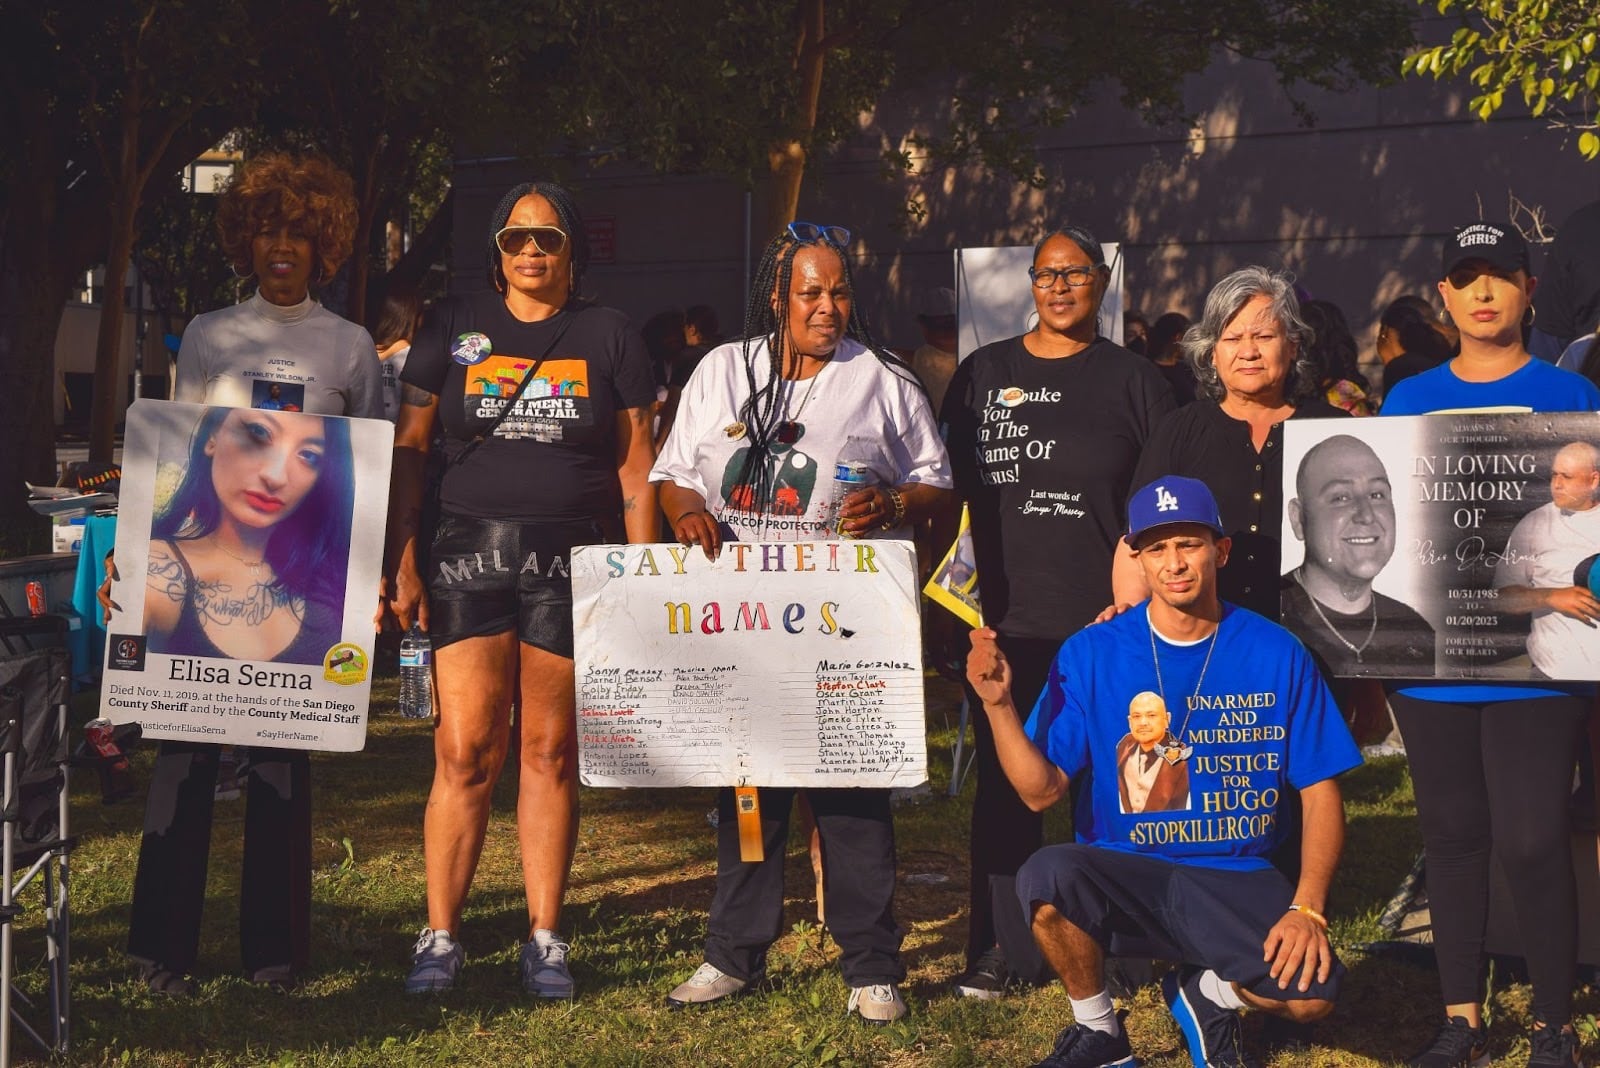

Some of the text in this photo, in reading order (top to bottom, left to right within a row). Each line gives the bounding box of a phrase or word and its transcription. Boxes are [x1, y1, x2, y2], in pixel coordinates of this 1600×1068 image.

[1457, 224, 1486, 241] JUSTICE
[1460, 233, 1497, 247] CHRIS
[267, 359, 295, 367] JUSTICE
[480, 397, 574, 409] CLOE MEN'S
[546, 408, 579, 419] JAIL
[983, 406, 1012, 424] You
[996, 421, 1029, 440] The
[1026, 440, 1056, 460] Of
[1411, 454, 1536, 476] IN LOVING
[1030, 489, 1081, 502] Last words of
[1420, 480, 1527, 501] MEMORY
[1155, 486, 1178, 511] LA
[741, 516, 764, 529] COP
[1453, 508, 1486, 528] OF
[606, 543, 879, 578] SAY THEIR
[1445, 637, 1483, 646] FOREVER
[816, 659, 851, 673] Mario
[168, 658, 313, 690] Elisa Serna
[584, 674, 662, 684] Darnell Benson
[816, 672, 877, 682] Steven Taylor
[581, 684, 611, 695] Colby
[857, 680, 887, 690] Clark
[109, 684, 134, 695] Died
[137, 686, 160, 698] Nov.
[202, 693, 212, 701] at
[216, 692, 233, 702] the
[235, 693, 267, 705] hands
[269, 696, 282, 706] of
[283, 697, 301, 707] the
[302, 698, 322, 709] San
[325, 700, 355, 713] Diego
[816, 689, 882, 698] Oscar Grant
[818, 698, 855, 706] Martin
[1187, 692, 1276, 711] UNARMED
[108, 697, 361, 724] County Sheriff and by the County Medical Staff
[816, 706, 880, 715] John Horton
[618, 716, 662, 728] Armstrong
[852, 714, 882, 724] Tyler
[1218, 711, 1257, 726] AND
[818, 721, 897, 731] Juan Correa Jr.
[256, 729, 319, 742] #SayHerName
[857, 731, 894, 739] Thomas
[1188, 726, 1286, 744] MURDERED
[847, 739, 875, 748] Malik
[878, 739, 906, 749] Young
[618, 750, 649, 759] Lopez
[818, 748, 855, 759] Stanley
[859, 747, 891, 756] Wilson
[861, 756, 876, 764] Lee
[1195, 752, 1280, 774] JUSTICE
[833, 767, 857, 775] many
[1222, 775, 1251, 788] FOR
[1202, 788, 1280, 814] HUGO
